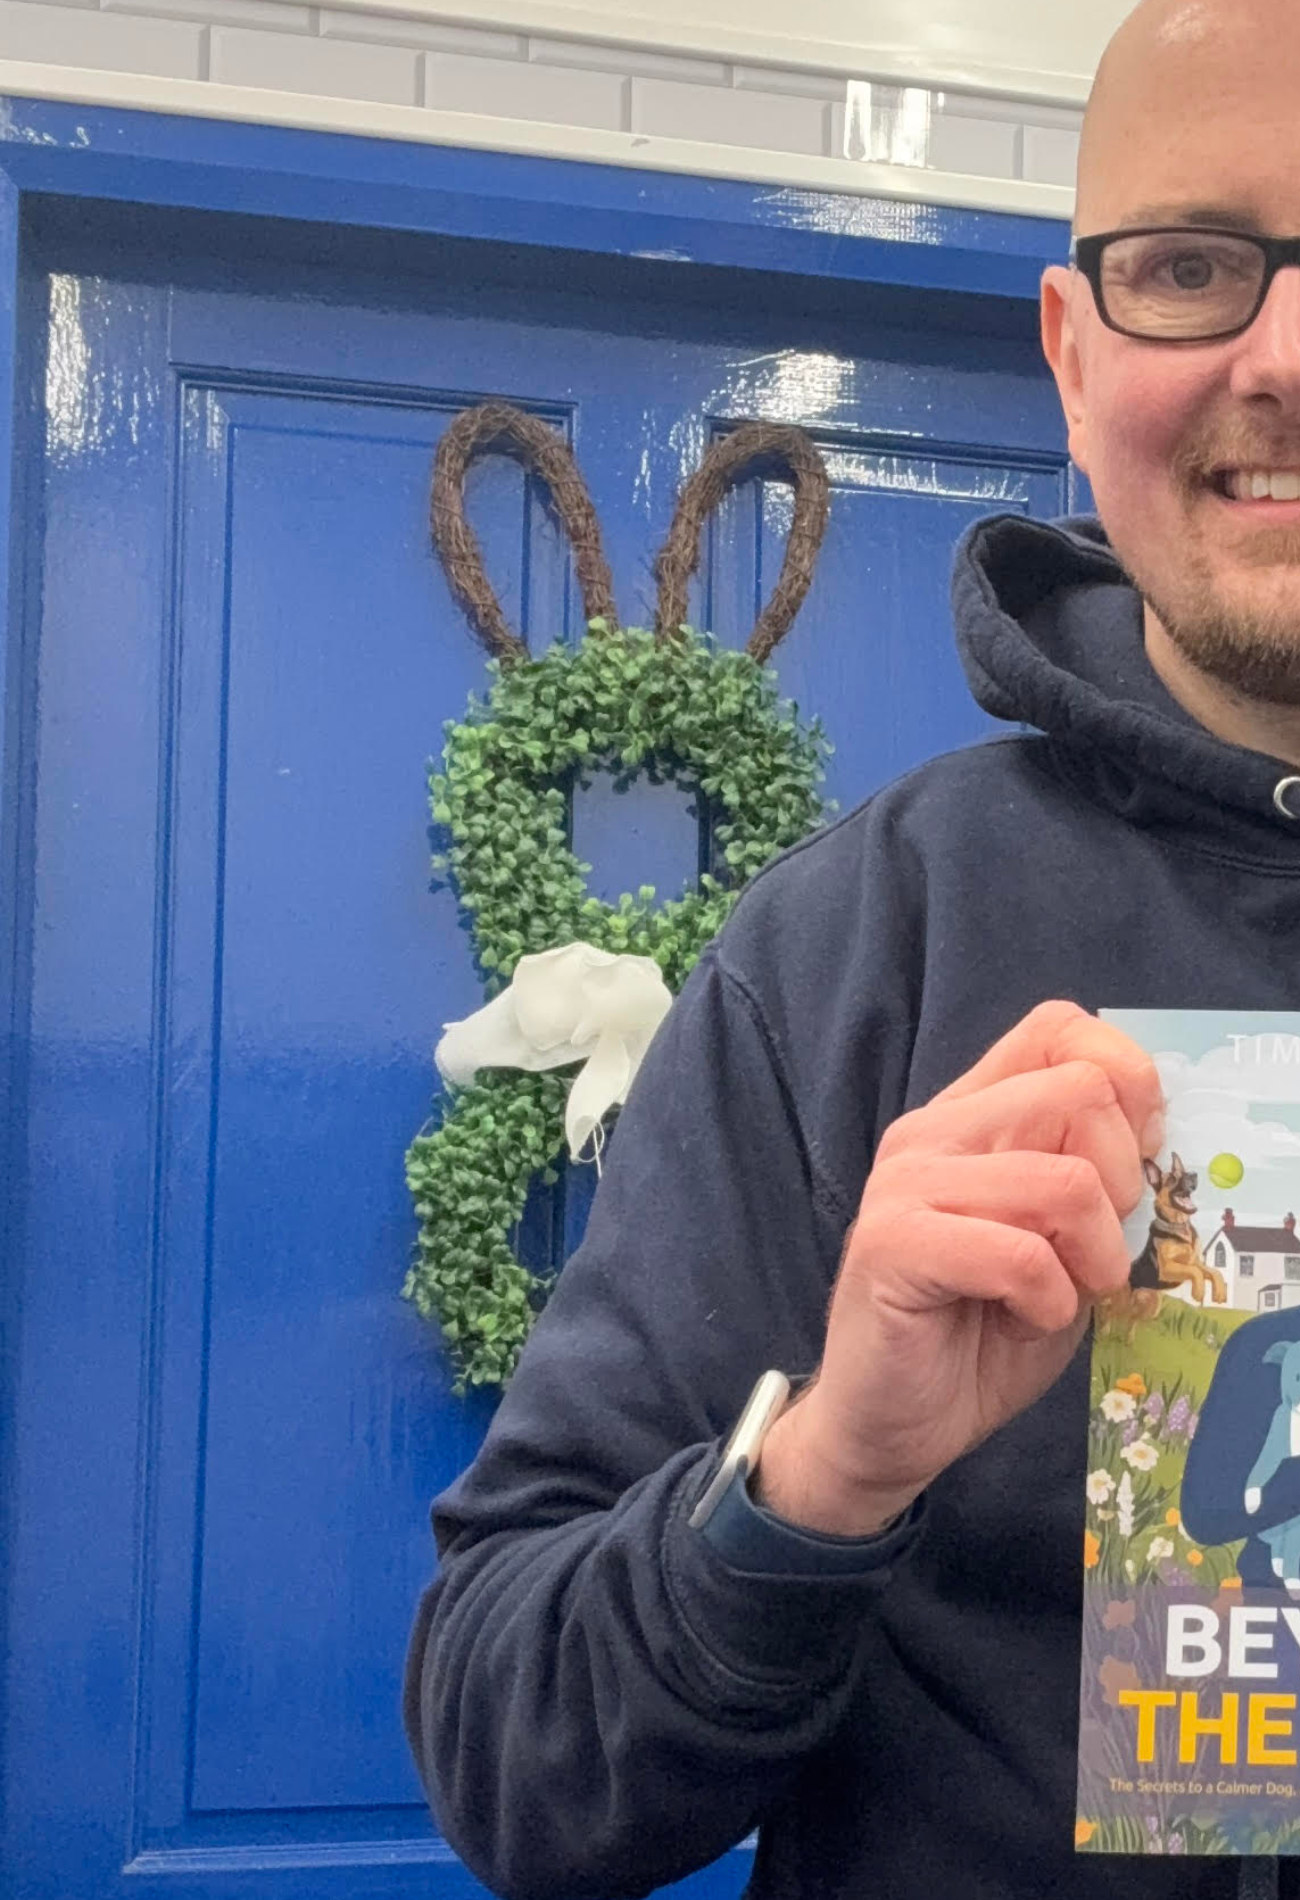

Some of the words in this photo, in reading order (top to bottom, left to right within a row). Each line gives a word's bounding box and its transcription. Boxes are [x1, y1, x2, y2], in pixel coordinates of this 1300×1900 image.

[1226, 1034, 1300, 1064] TIM
[1118, 1690, 1297, 1765] THE
[1109, 1778, 1134, 1792] The
[1137, 1778, 1186, 1793] Secrets
[1188, 1780, 1202, 1793] to
[1206, 1783, 1213, 1793] a
[1216, 1780, 1262, 1795] Calmer
[1266, 1781, 1296, 1797] Dog,
